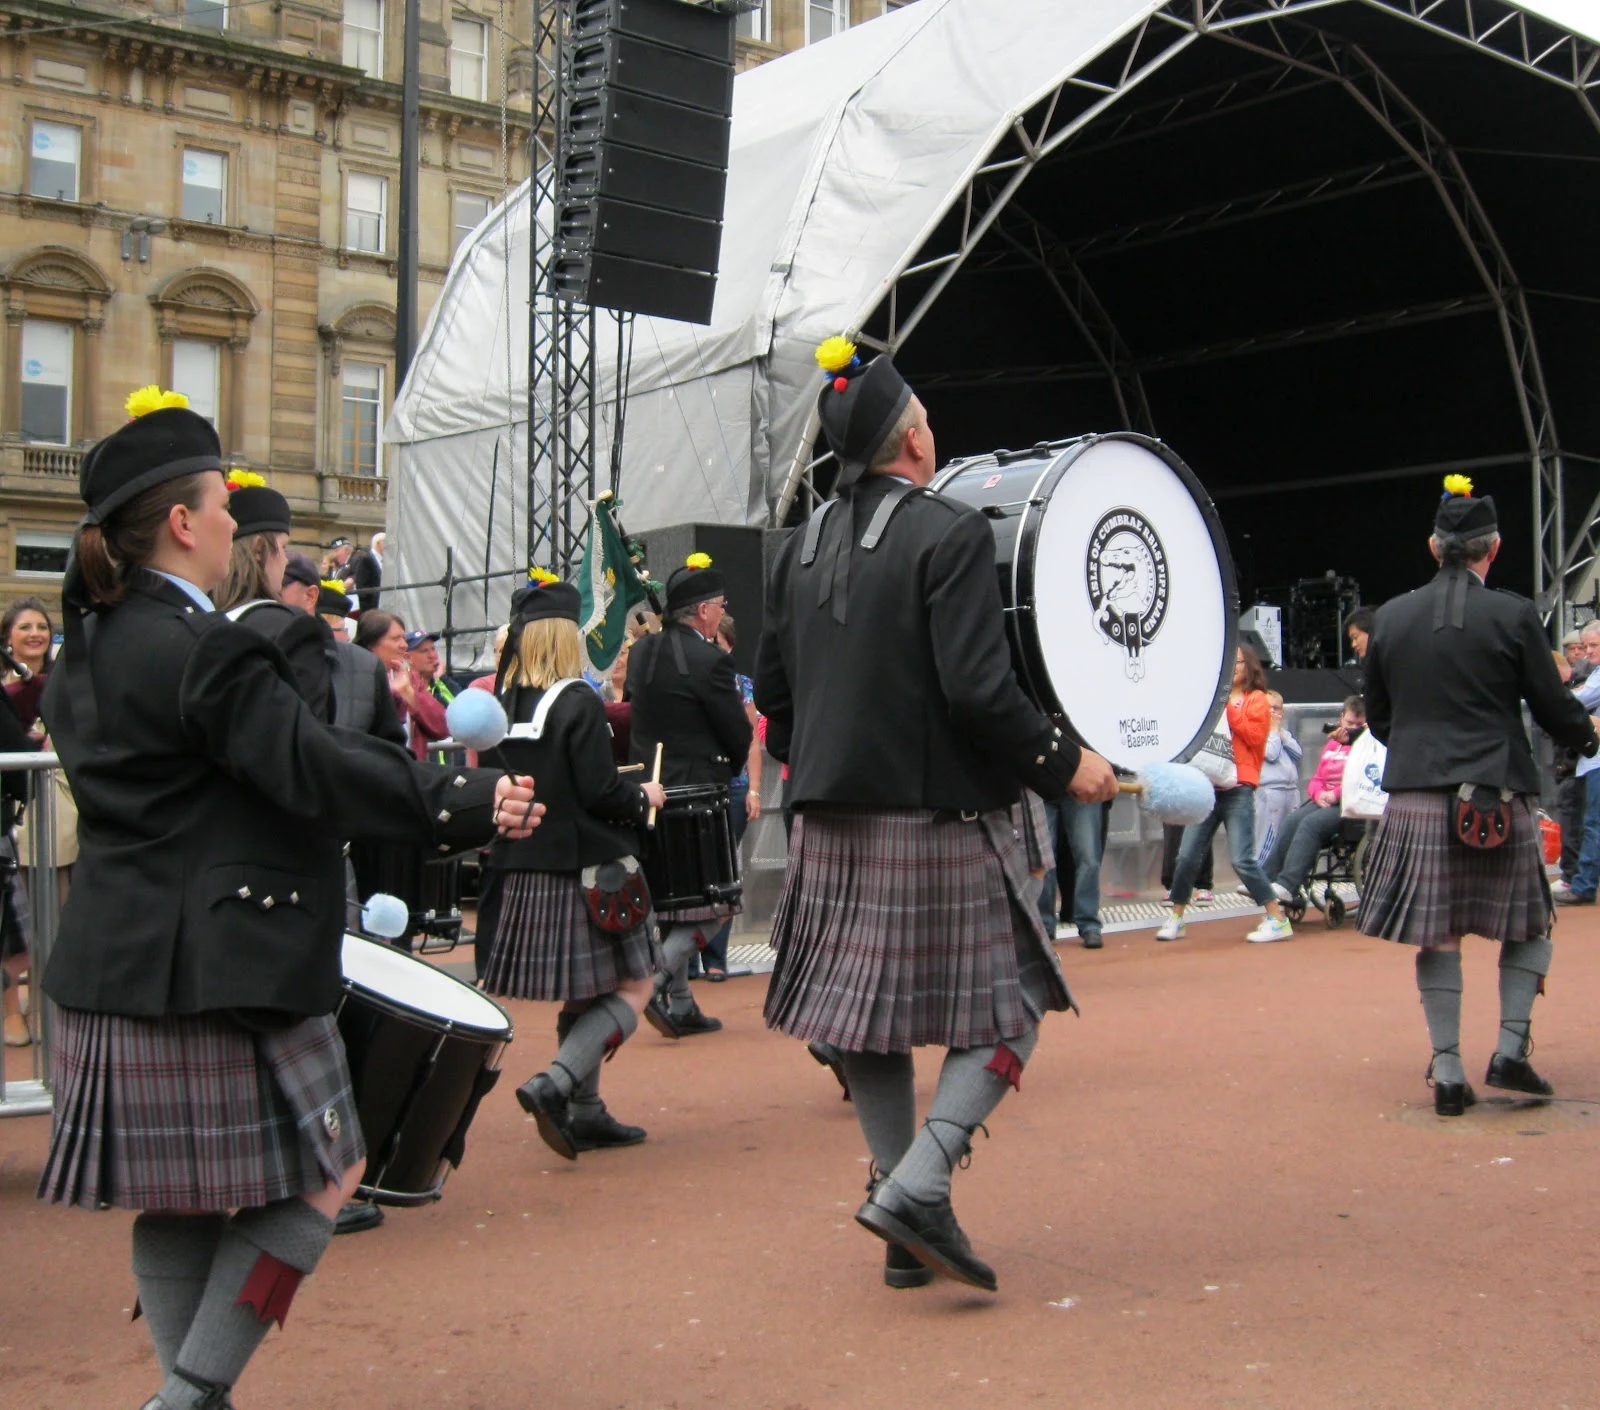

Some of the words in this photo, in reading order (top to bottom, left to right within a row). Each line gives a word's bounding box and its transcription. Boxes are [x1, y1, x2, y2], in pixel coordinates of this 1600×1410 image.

[1098, 514, 1144, 540] CUMBRAE
[1091, 538, 1102, 560] OF
[1142, 526, 1163, 562] RBLS
[1089, 561, 1101, 598] ISLE
[1157, 563, 1167, 598] PIPE
[1143, 598, 1165, 633] BAND
[1119, 716, 1159, 734] McCallum
[1127, 733, 1159, 748] Bagpipes
